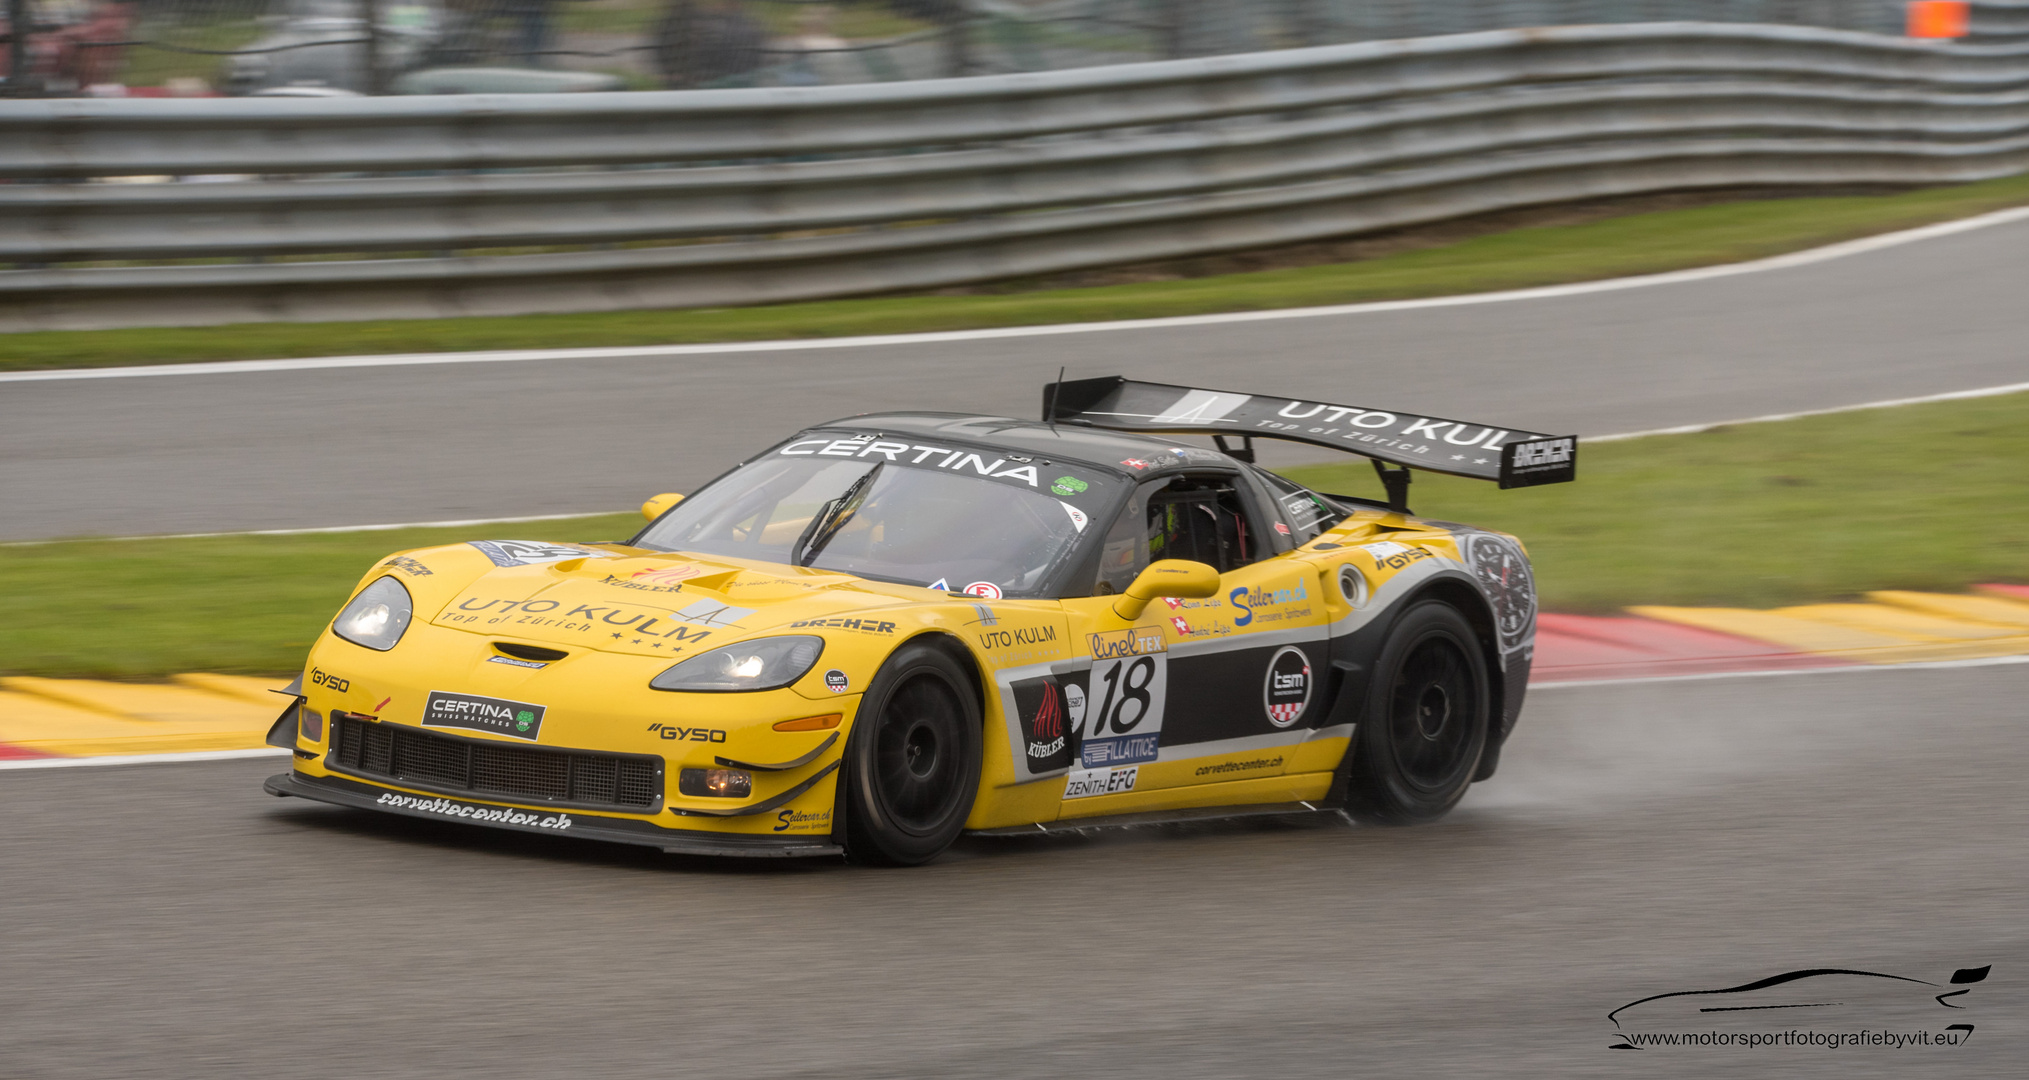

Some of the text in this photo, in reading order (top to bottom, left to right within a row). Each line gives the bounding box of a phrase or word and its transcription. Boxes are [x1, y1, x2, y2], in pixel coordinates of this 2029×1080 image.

[1256, 419, 1430, 454] Top of Zürich
[1278, 401, 1543, 451] UTO KUL
[780, 440, 1038, 487] CERTINA
[1380, 547, 1433, 570] GYSO
[598, 574, 683, 593] KÜBLER
[1229, 577, 1308, 627] Seilercar.ch
[442, 612, 592, 632] Top of Zürich
[458, 597, 712, 643] UTO KULM
[790, 619, 897, 633] DREHER
[980, 625, 1057, 650] UTO KULM
[311, 667, 350, 693] GYSO
[1274, 670, 1304, 689] tsm
[1093, 655, 1156, 737] 18
[432, 699, 514, 720] CERTINA
[464, 715, 510, 727] WATCHES
[658, 724, 727, 743] GYSO
[1028, 736, 1065, 758] KÜBLER
[1105, 737, 1157, 760] FILLATTICE
[1195, 754, 1284, 776] corvettecenter.ch
[1065, 769, 1136, 796] ZENITH EFG
[377, 793, 572, 829] corvettecenter.ch
[773, 807, 832, 831] Seilercar.ch
